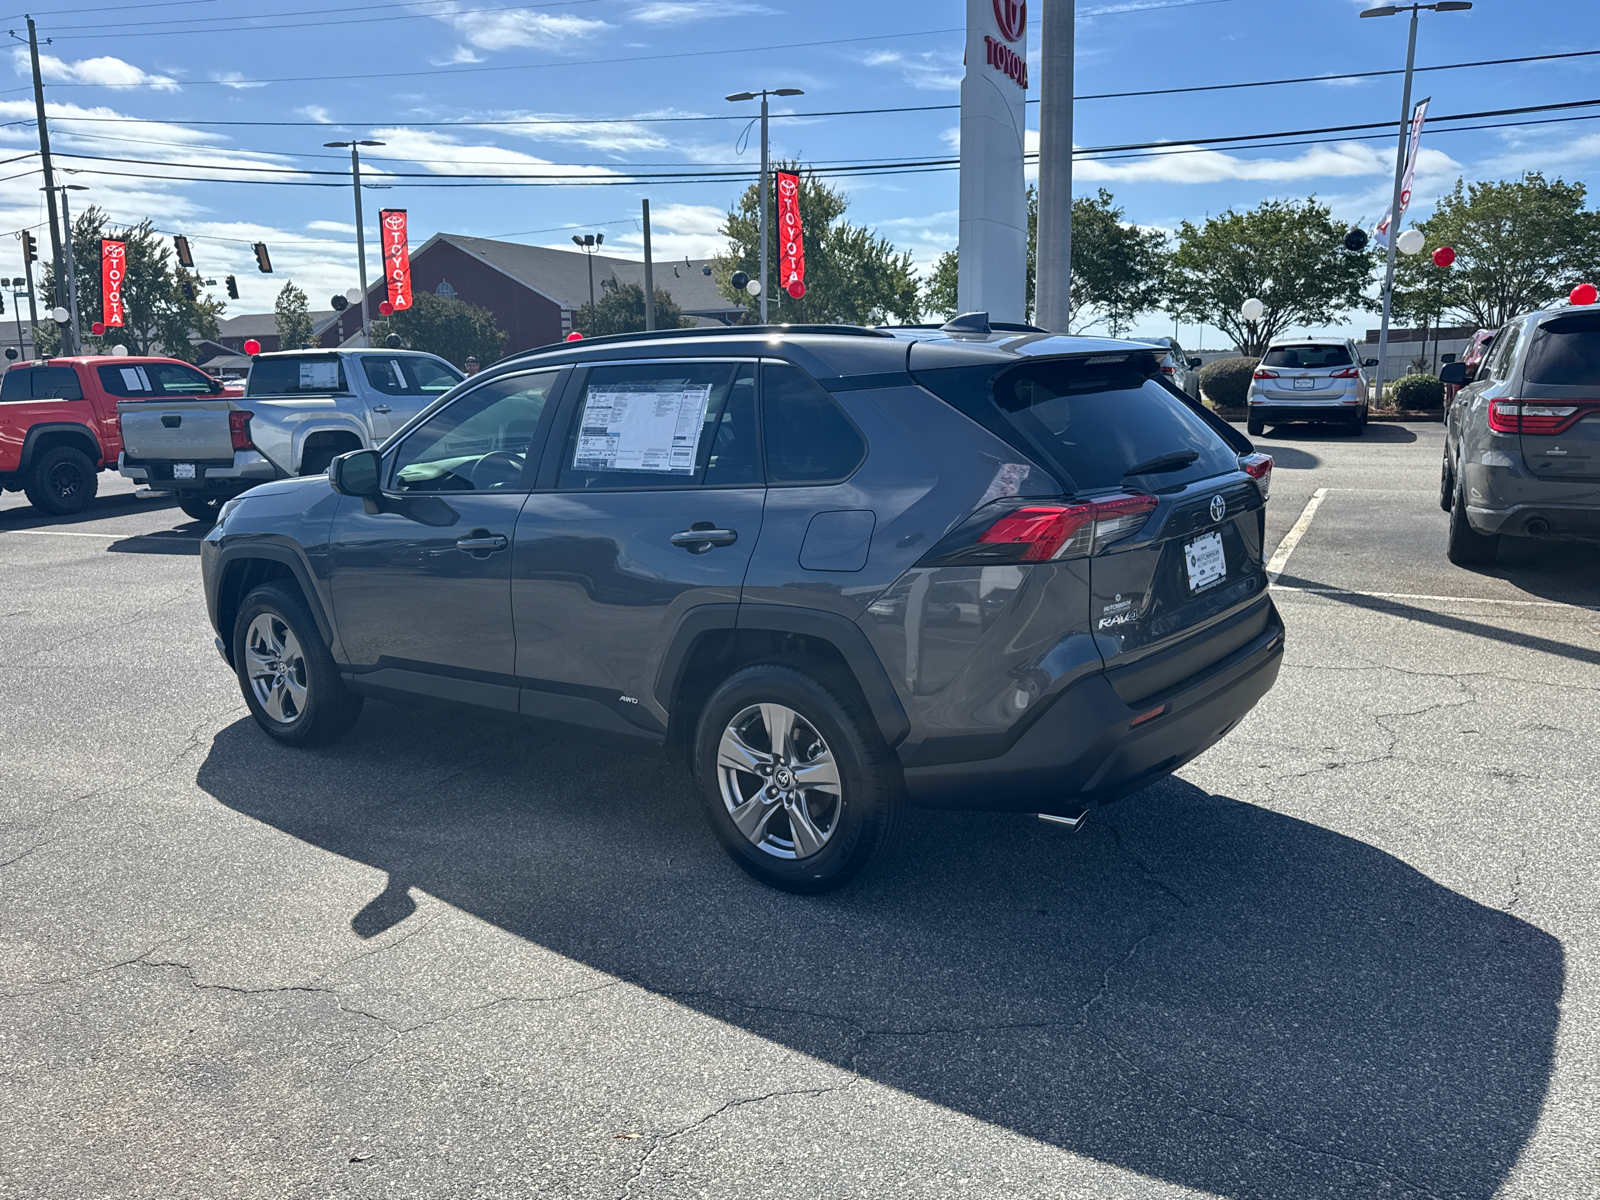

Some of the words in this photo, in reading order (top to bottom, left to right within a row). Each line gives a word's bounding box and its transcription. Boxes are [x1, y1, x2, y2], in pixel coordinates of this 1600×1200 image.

[984, 35, 1028, 89] TOYOTA
[784, 198, 798, 282] TOYOTA
[109, 259, 121, 323] TOYOTA
[391, 232, 406, 306] TOYOTA
[1098, 609, 1138, 630] RAV4
[1103, 600, 1131, 612] HUTCHINSON
[619, 695, 639, 704] AWD
